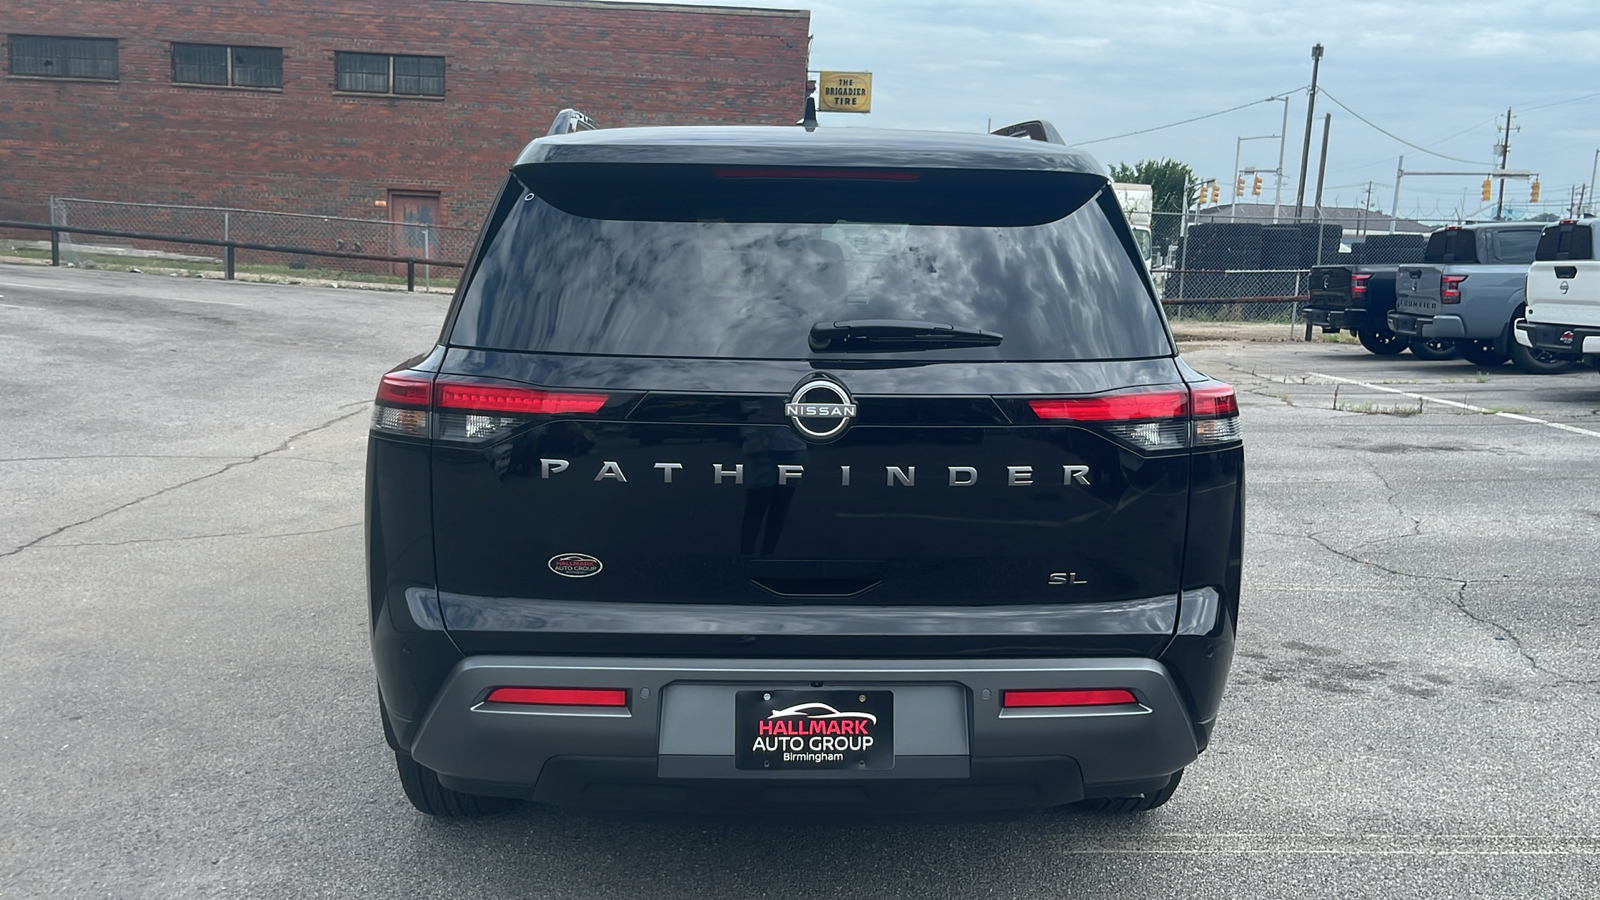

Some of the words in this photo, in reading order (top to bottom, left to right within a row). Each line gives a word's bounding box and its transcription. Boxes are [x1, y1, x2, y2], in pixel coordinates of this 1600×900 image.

[825, 87, 866, 96] BRIGADIER
[834, 97, 857, 105] TIRE
[787, 405, 855, 416] NISSAN
[540, 458, 1090, 487] PATHFINDER
[1048, 572, 1087, 585] SL
[759, 719, 868, 735] HALLMARK
[752, 736, 804, 751] AUTO
[809, 736, 874, 751] GROUP
[783, 752, 843, 763] Birmingham
